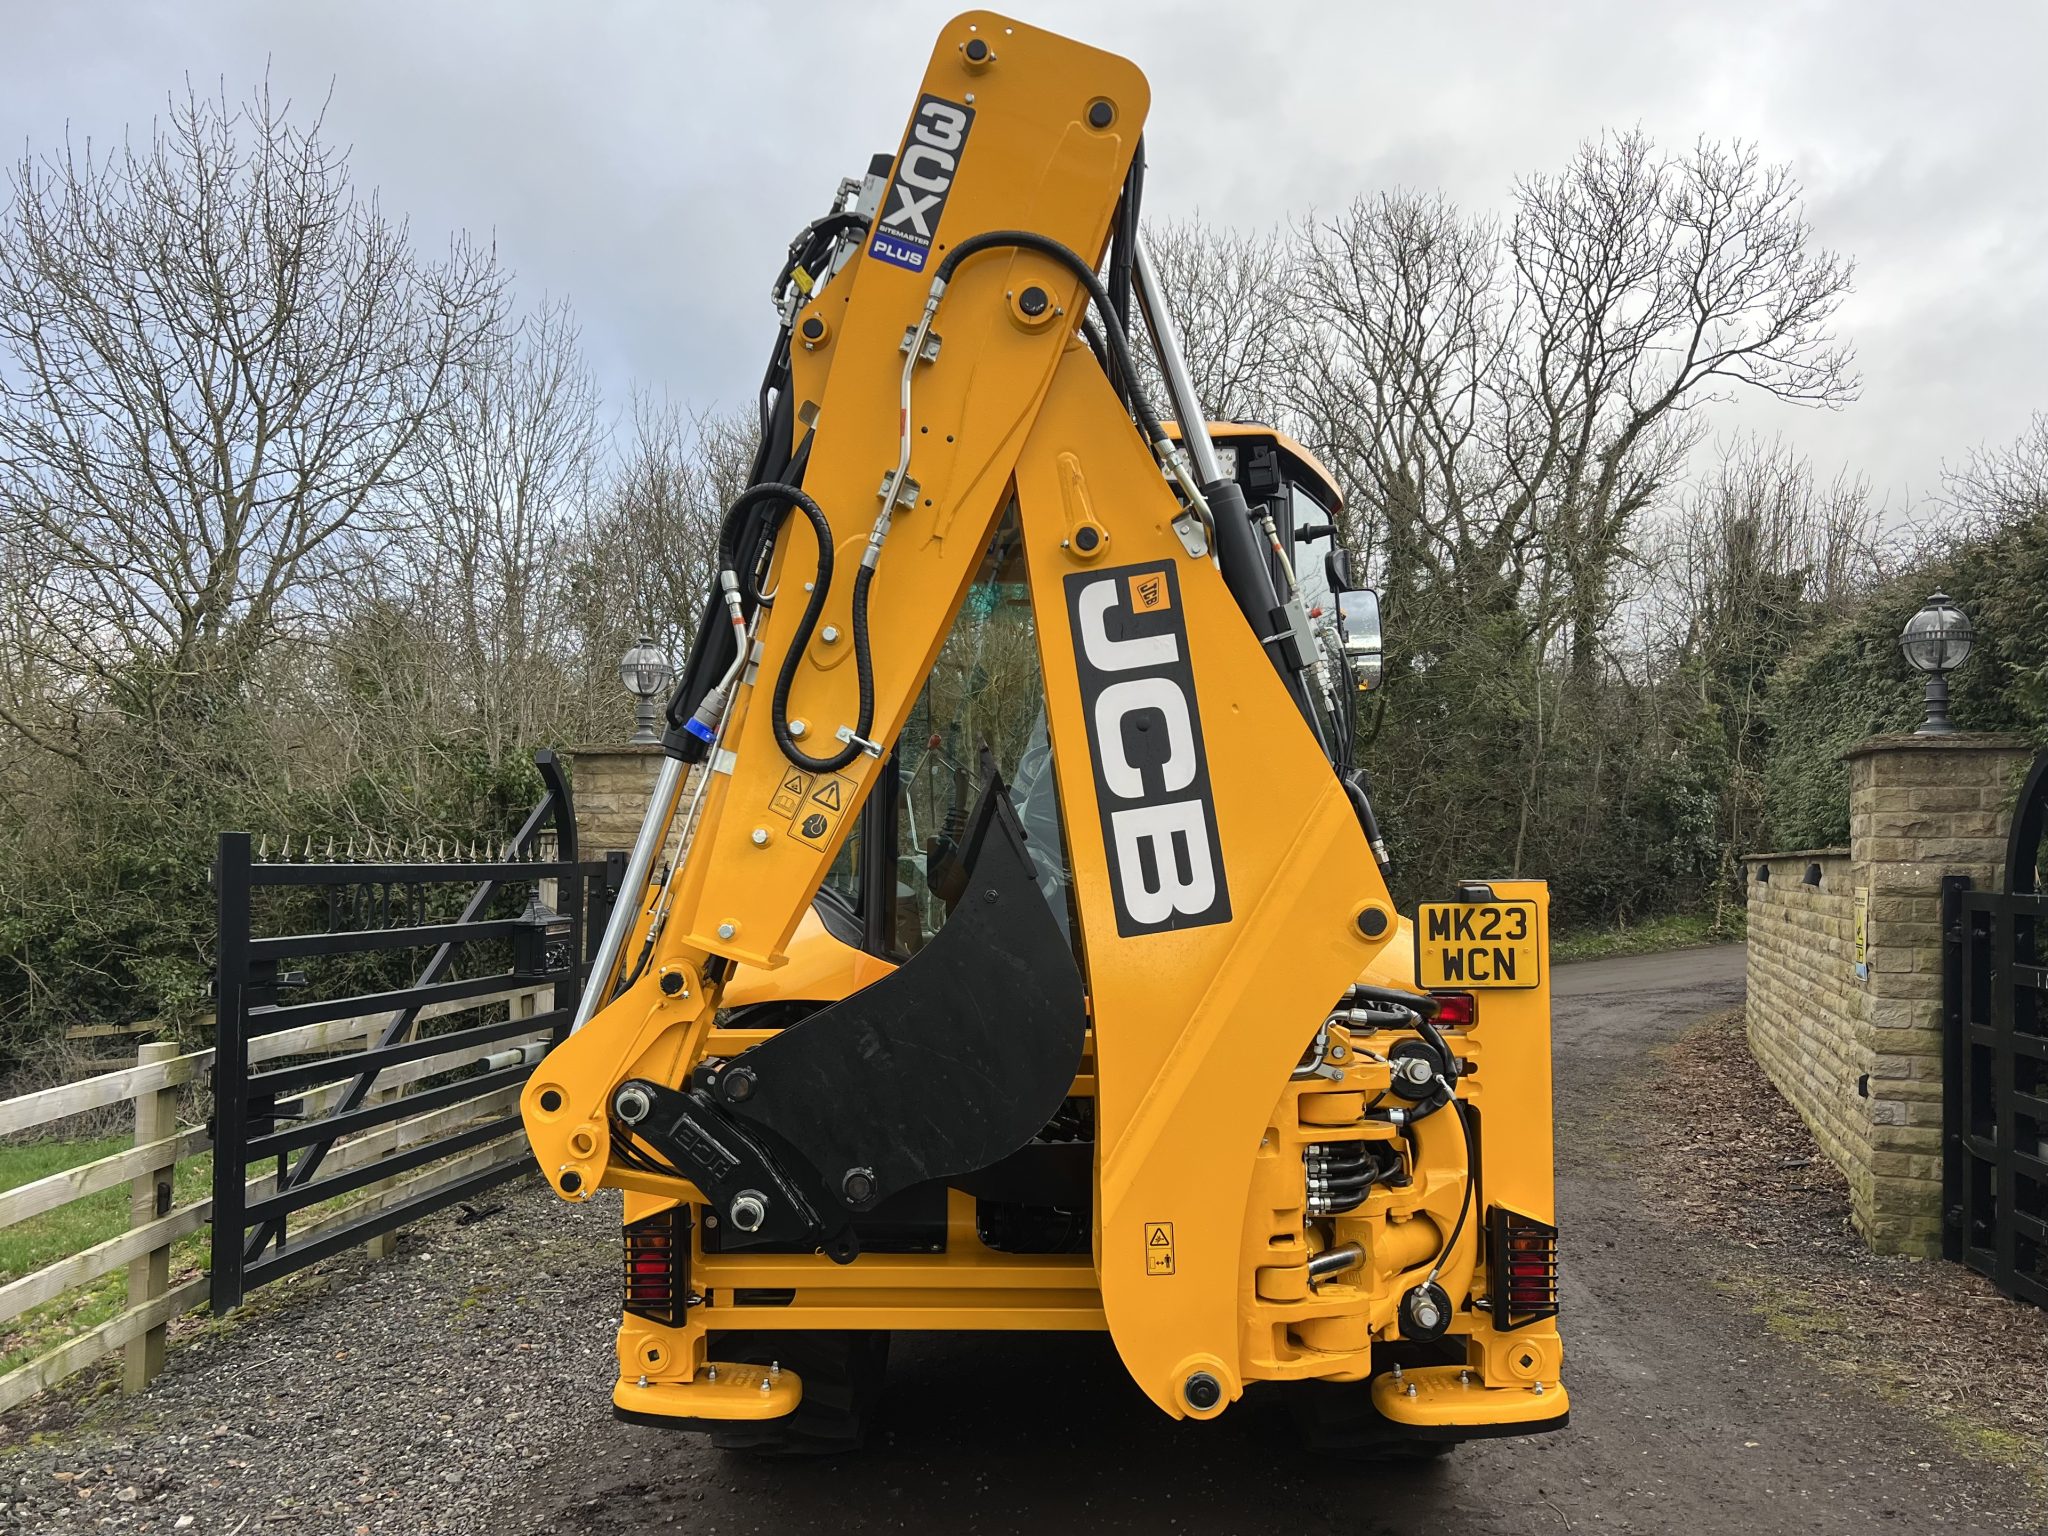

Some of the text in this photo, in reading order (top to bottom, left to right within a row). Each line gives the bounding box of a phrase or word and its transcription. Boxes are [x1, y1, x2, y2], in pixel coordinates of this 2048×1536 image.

[882, 102, 967, 237] 3CX
[878, 224, 930, 247] SITEMASTER
[874, 240, 923, 266] PLUS
[1139, 582, 1158, 606] JCB
[1078, 578, 1217, 924] JCB
[1428, 907, 1527, 941] MK23
[1442, 948, 1516, 981] WCN
